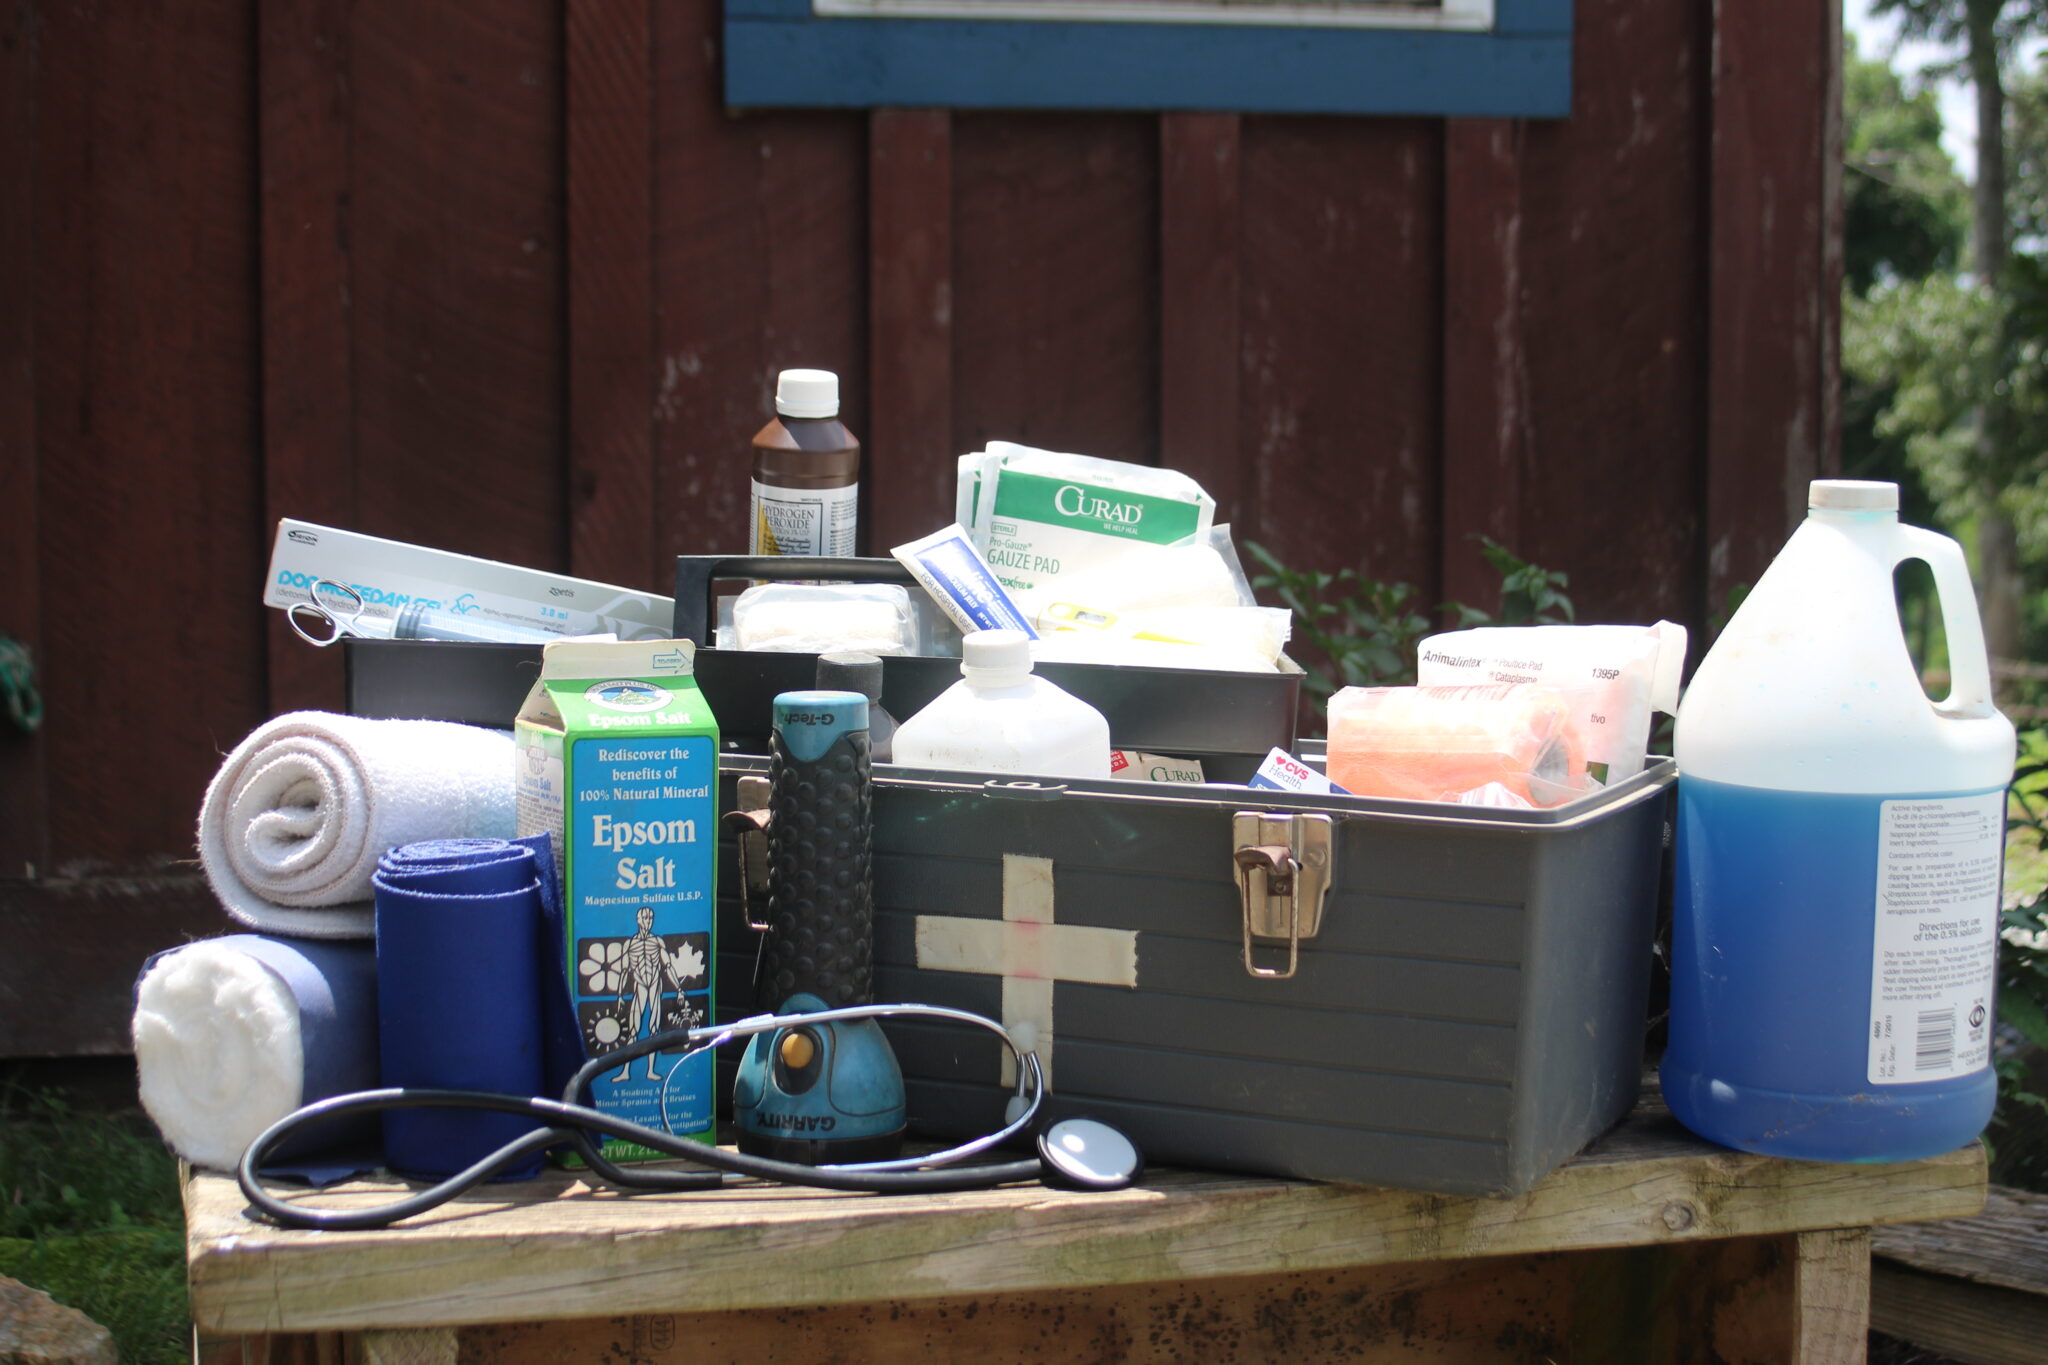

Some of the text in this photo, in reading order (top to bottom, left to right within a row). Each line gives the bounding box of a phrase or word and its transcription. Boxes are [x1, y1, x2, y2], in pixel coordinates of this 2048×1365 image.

[763, 504, 814, 520] HYDROGEN
[1054, 485, 1143, 524] CURAD
[992, 524, 1015, 534] STERILE
[1112, 524, 1125, 532] HELP
[1126, 526, 1138, 534] HEAL
[987, 548, 1060, 574] GAUZE PAD
[920, 572, 972, 630] FOR HOSPITAL USE
[1422, 650, 1482, 668] Animalintex
[1528, 660, 1543, 671] Pad
[1591, 668, 1620, 680] 1395P
[587, 712, 692, 728] Epsom Salt
[784, 712, 835, 726] G-Tech
[1590, 714, 1606, 724] tivo
[598, 746, 690, 762] Rediscover the
[612, 766, 678, 781] benefits of
[1150, 766, 1201, 782] CURAD
[1268, 764, 1302, 790] Health
[1284, 762, 1310, 780] CVS
[579, 784, 709, 802] 100% Natural Mineral
[592, 814, 696, 852] Epsom
[615, 856, 677, 890] Salt
[584, 890, 704, 908] Magnesium Sulfate U.S.P.
[1918, 920, 1958, 932] Directions
[1959, 919, 1968, 928] for
[1914, 932, 1923, 942] of
[1924, 931, 1939, 940] the
[1940, 930, 1958, 940] 0.5%
[596, 1100, 620, 1108] Minor
[621, 1098, 652, 1108] Sprains
[669, 1094, 696, 1104] Bruises
[612, 1090, 619, 1098] A
[620, 1088, 654, 1098] Soaking
[668, 1112, 679, 1120] for
[680, 1110, 692, 1119] the
[758, 1112, 836, 1132] GARRITY
